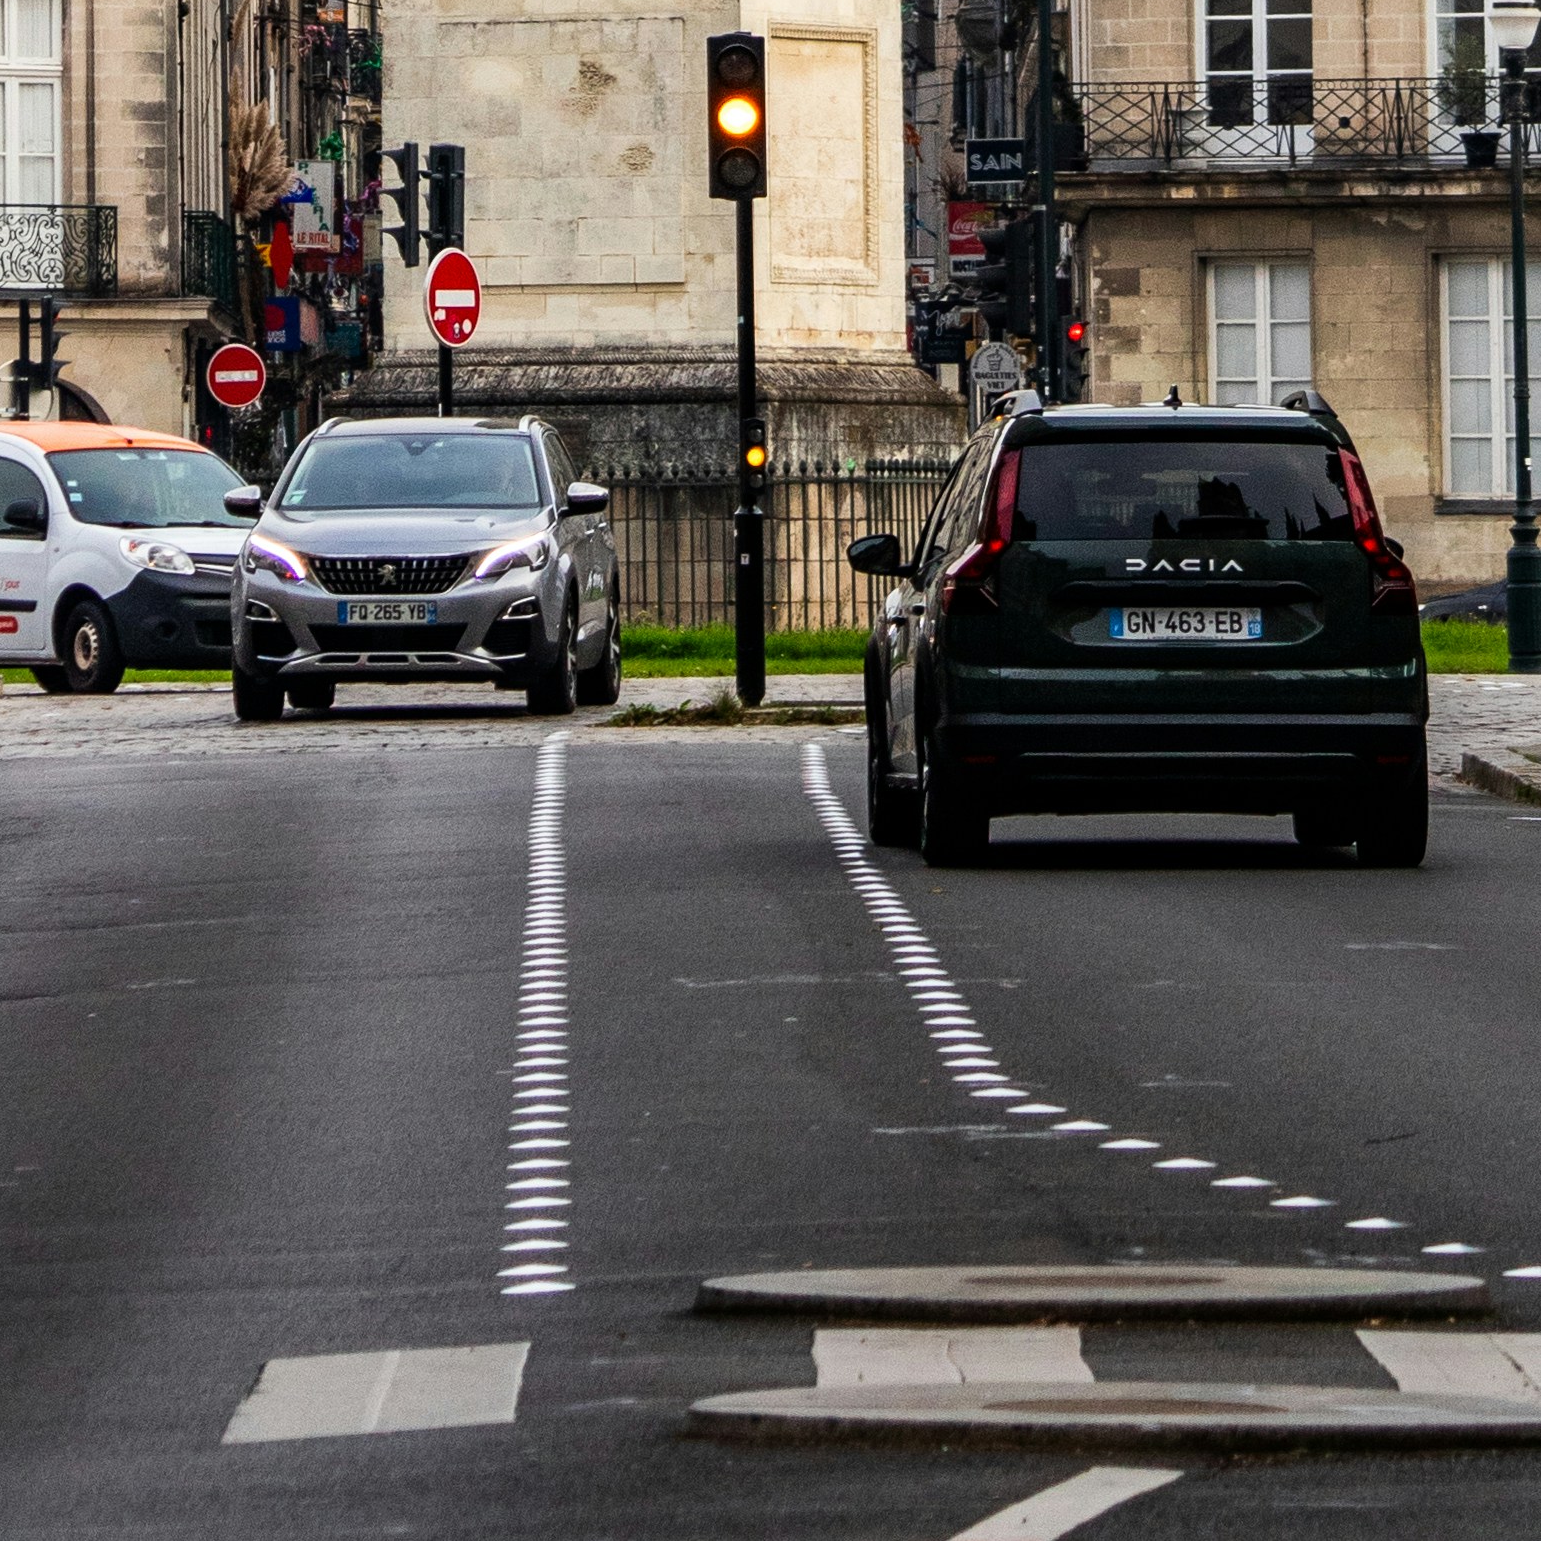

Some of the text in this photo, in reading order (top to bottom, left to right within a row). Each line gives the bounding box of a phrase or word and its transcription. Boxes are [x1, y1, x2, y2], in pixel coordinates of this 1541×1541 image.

[970, 152, 1022, 170] SAIN
[297, 231, 329, 244] LE RITAL
[1125, 558, 1244, 572] DACIA
[349, 604, 426, 621] FQ-265-YB
[1127, 611, 1243, 634] GN-463-EB
